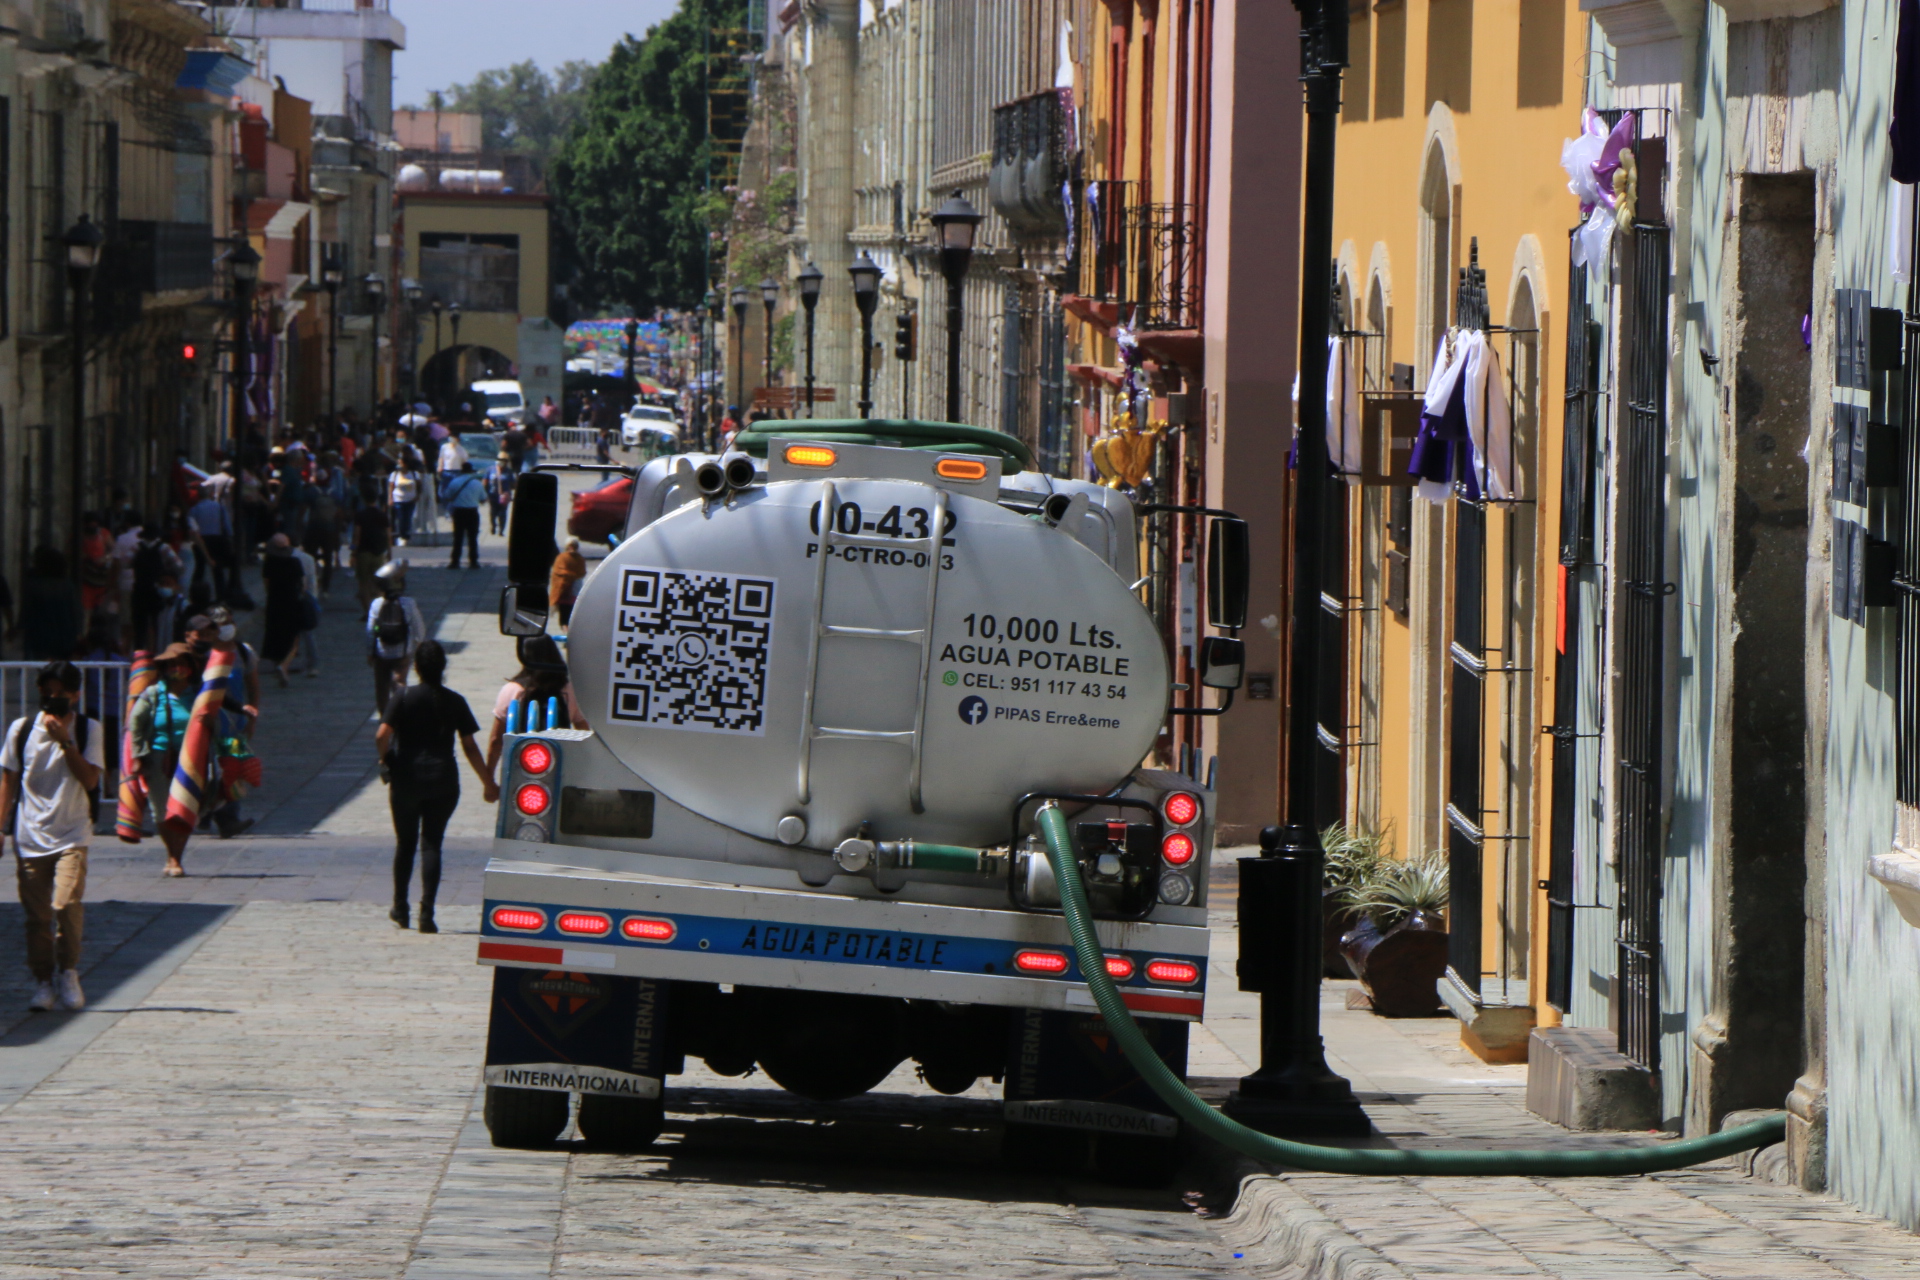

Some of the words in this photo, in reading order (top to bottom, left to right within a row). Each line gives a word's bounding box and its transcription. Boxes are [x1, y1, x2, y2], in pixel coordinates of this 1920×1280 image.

[810, 500, 957, 547] 00-432
[806, 543, 954, 571] PP-CTRO-03
[963, 613, 1059, 644] 10,000
[1069, 622, 1122, 649] Lts.
[940, 643, 1011, 667] AGUA
[1018, 649, 1129, 676] POTABLE
[963, 672, 1005, 690] CEL:
[1011, 676, 1040, 692] 951
[1047, 680, 1076, 695] 117
[1081, 683, 1101, 698] 43
[1107, 685, 1127, 700] 54
[994, 706, 1041, 722] PIPAS
[1046, 710, 1120, 729] Erre&eme
[504, 1069, 640, 1095] INTERNATIONAL
[1023, 1106, 1156, 1132] INTERNATIONAL
